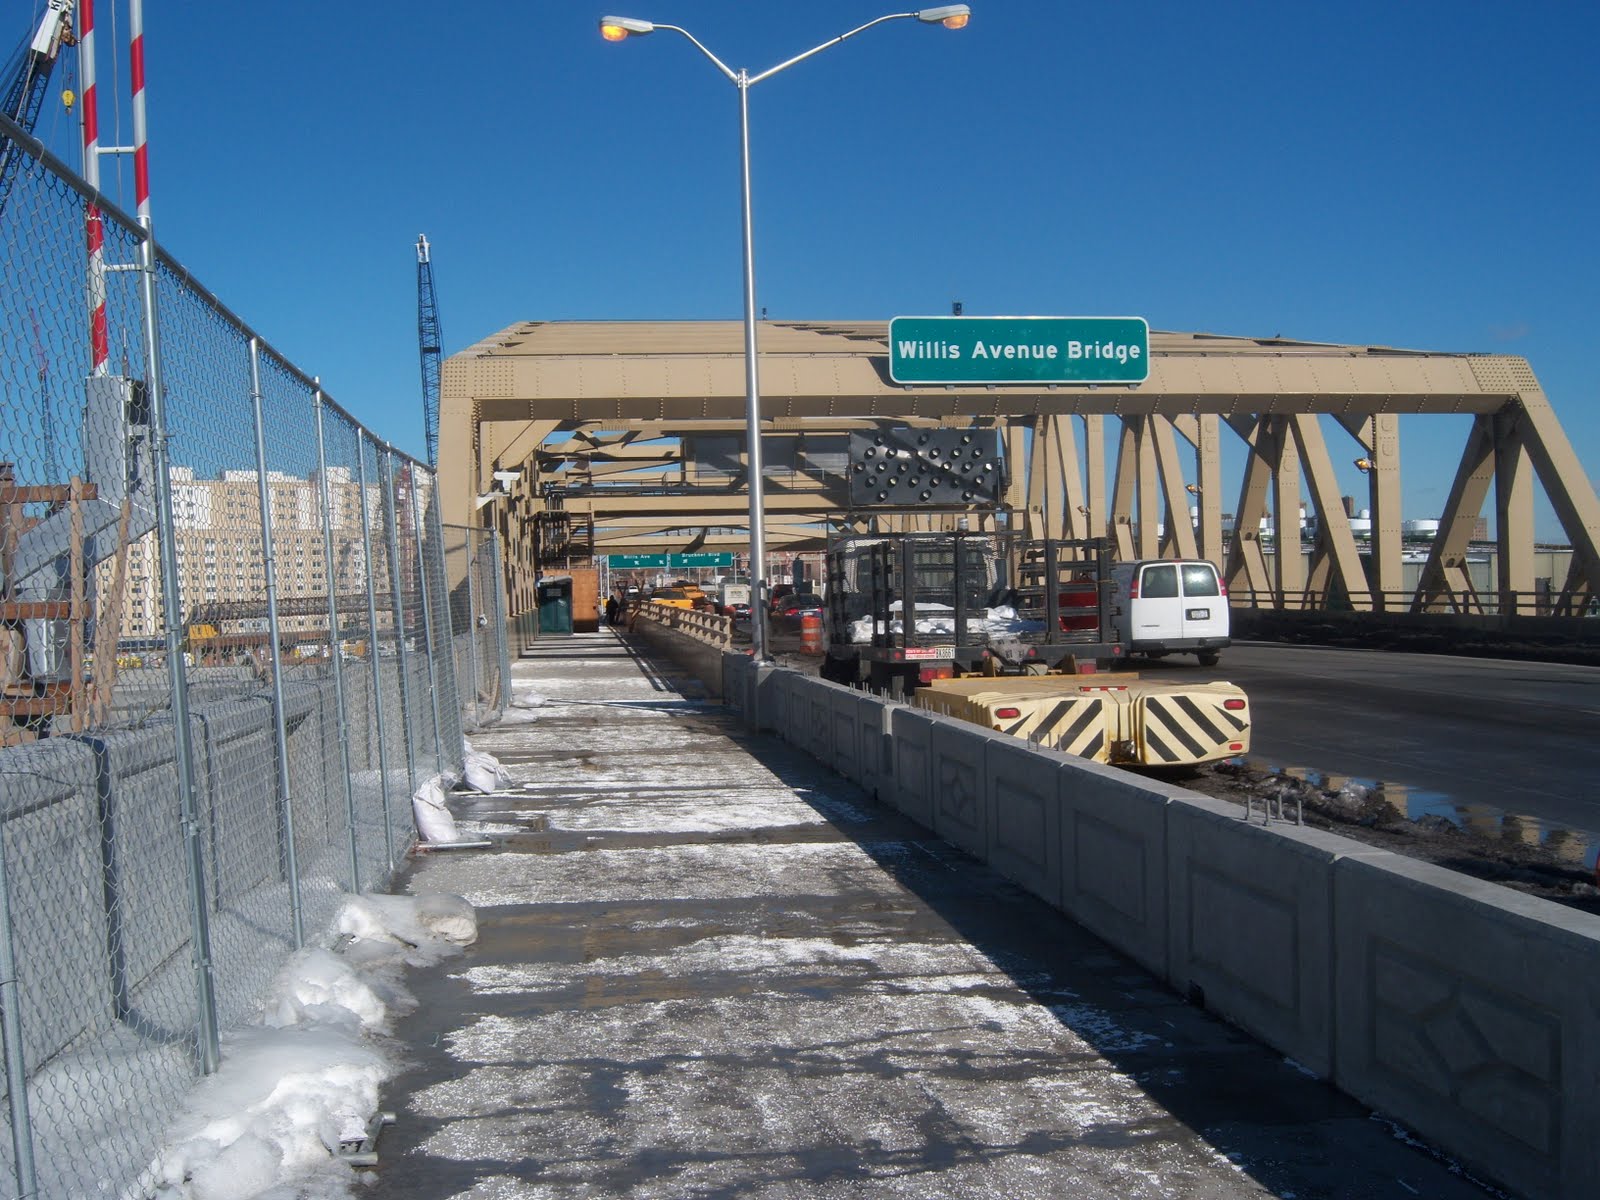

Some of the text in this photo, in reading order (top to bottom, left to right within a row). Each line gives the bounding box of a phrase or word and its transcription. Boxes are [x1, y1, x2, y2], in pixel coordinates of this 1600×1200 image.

[898, 340, 1141, 364] Willis Avenue Bridge
